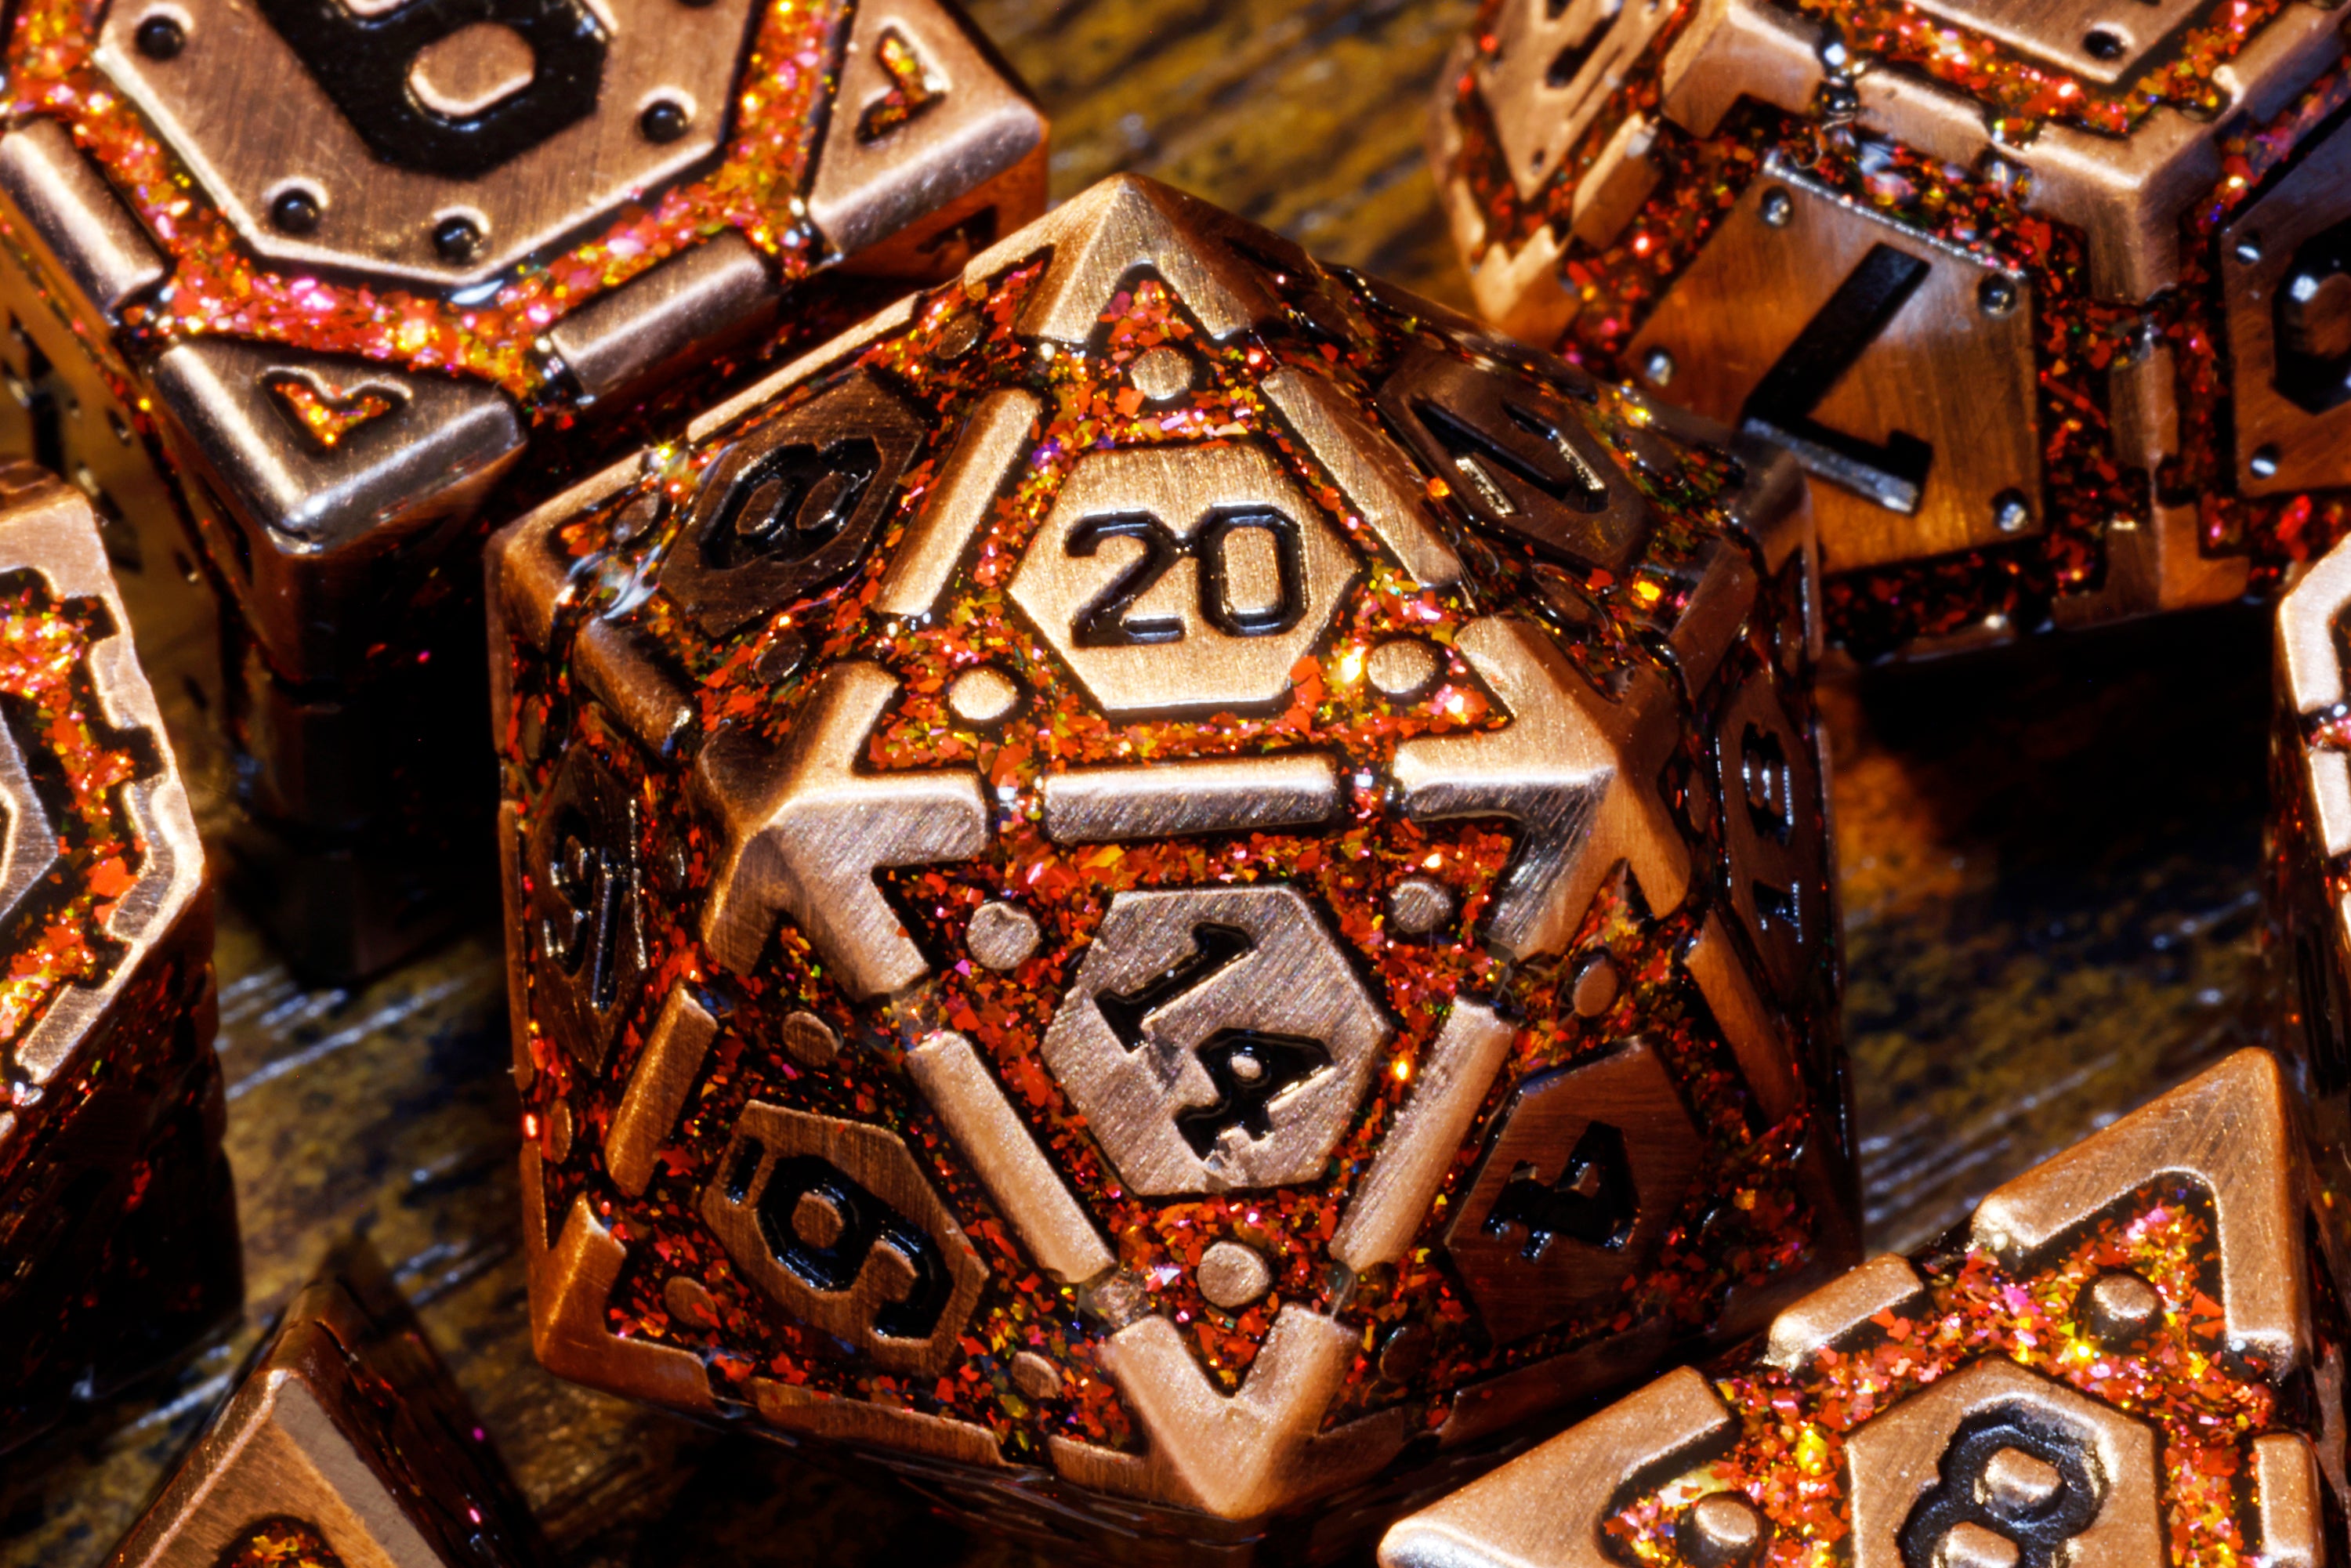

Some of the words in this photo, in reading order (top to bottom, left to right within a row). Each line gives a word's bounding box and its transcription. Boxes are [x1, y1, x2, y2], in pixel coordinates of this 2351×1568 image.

[700, 433, 884, 571] 8
[1408, 397, 1610, 514] 2
[1064, 501, 1308, 647] 20
[1095, 921, 1335, 1163] 14
[1481, 1121, 1641, 1263] 4
[1895, 1401, 2111, 1568] 8
